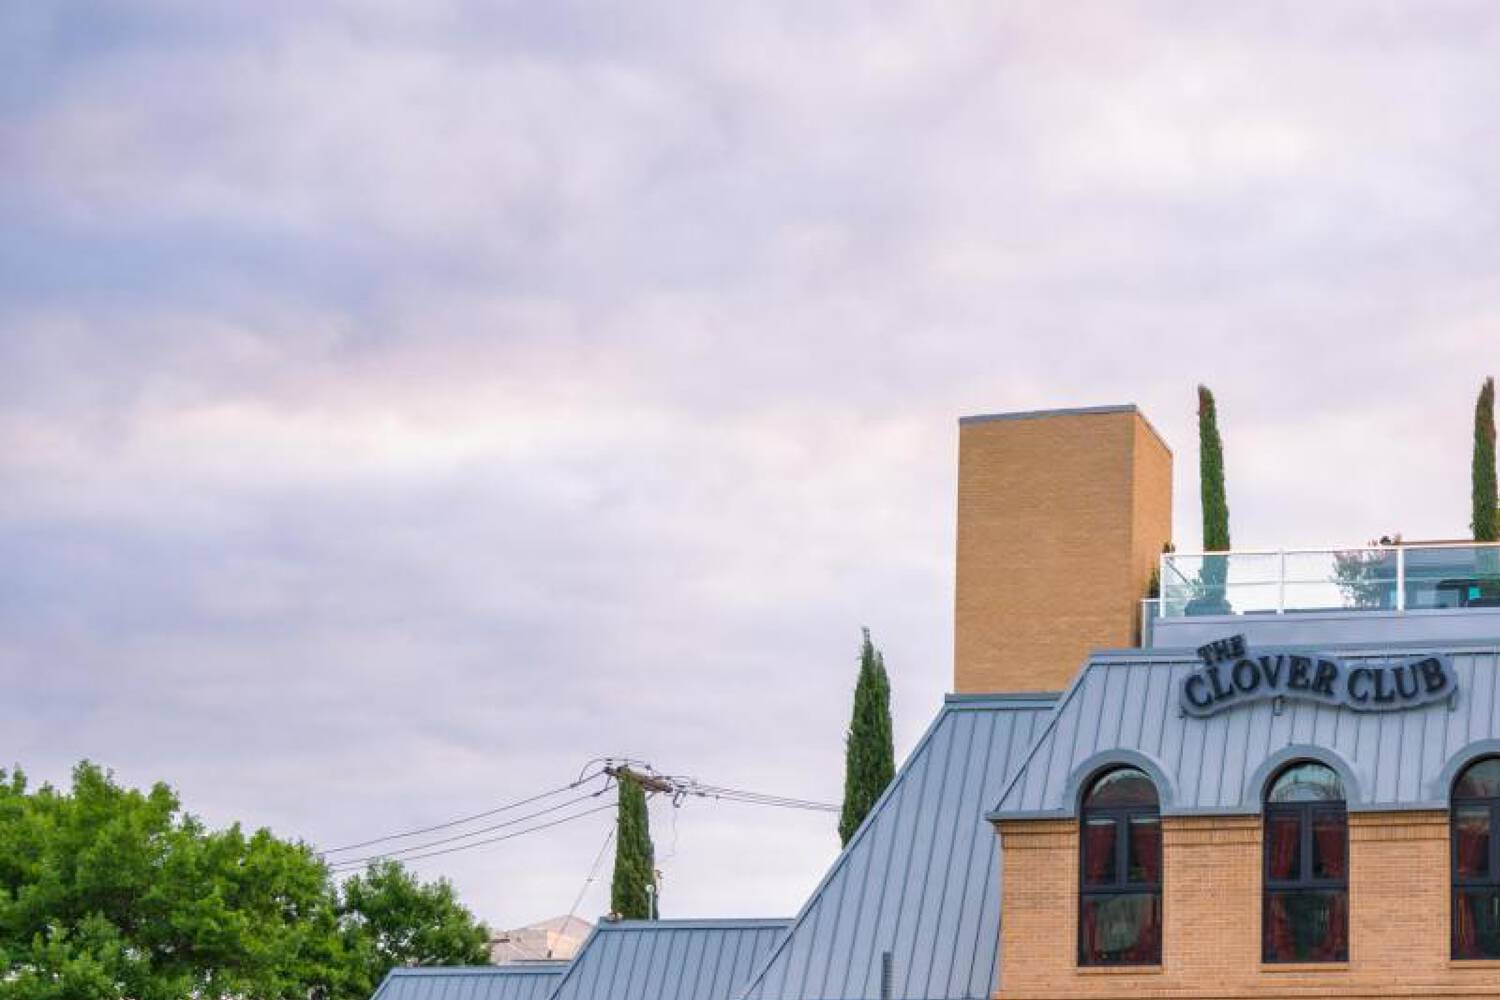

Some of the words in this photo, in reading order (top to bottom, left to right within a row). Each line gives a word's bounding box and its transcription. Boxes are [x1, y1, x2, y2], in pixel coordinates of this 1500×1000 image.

[1197, 634, 1245, 666] THE
[1184, 655, 1338, 706] CLOVER
[1347, 657, 1446, 702] CLUB
